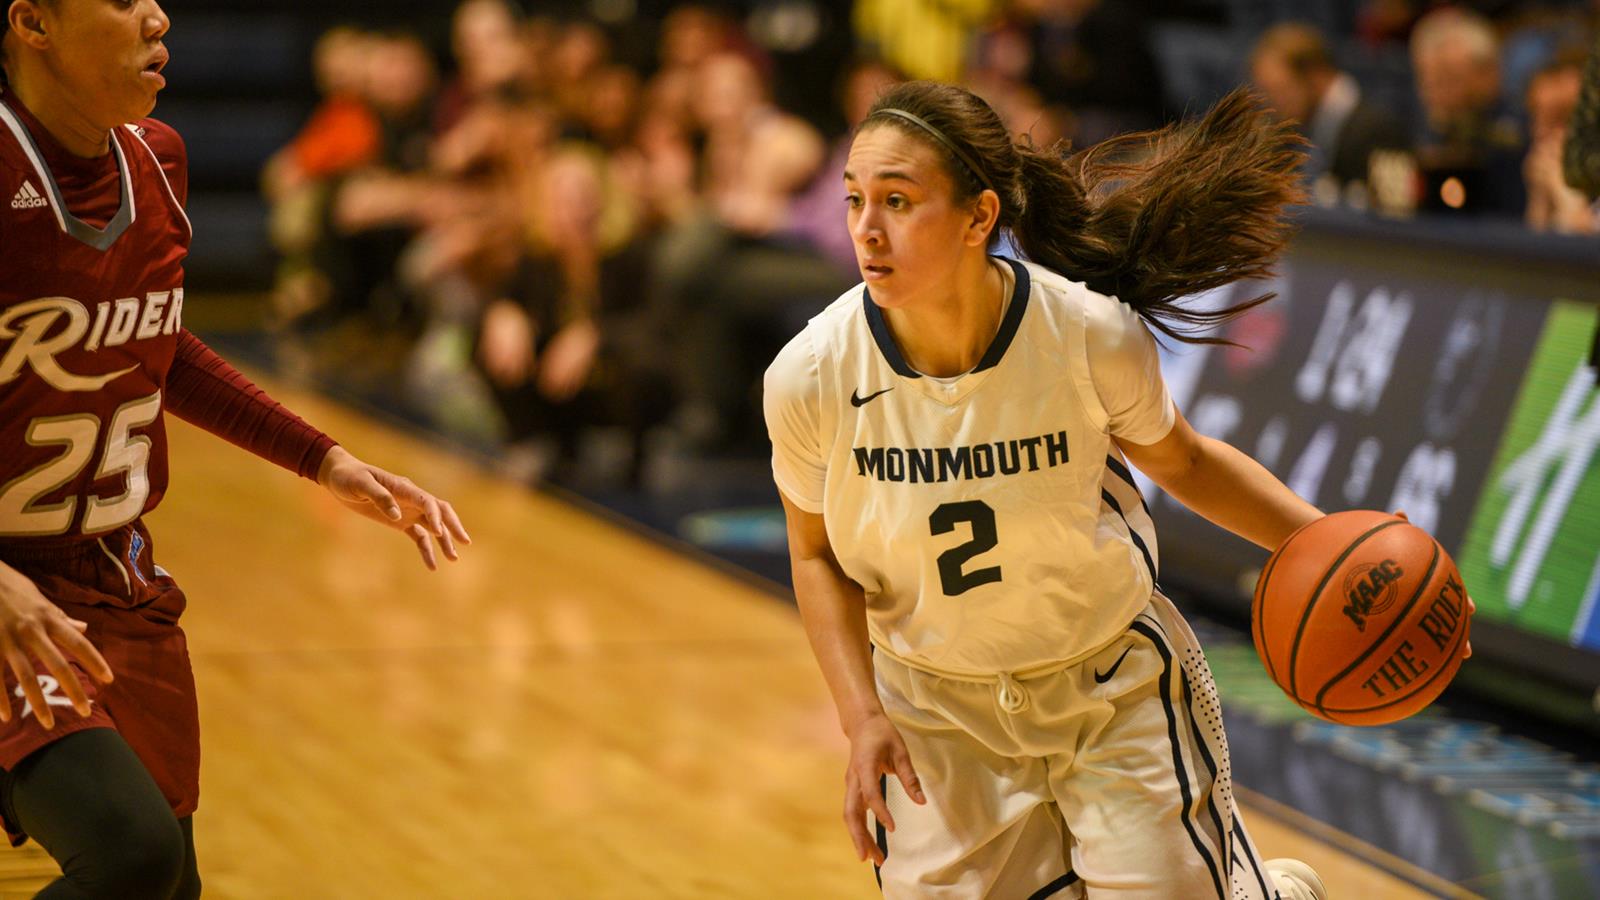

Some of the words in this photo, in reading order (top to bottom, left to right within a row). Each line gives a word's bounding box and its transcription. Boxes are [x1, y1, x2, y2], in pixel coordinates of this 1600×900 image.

[11, 196, 48, 209] adidas
[0, 287, 184, 392] RIDER
[0, 388, 162, 536] 25
[853, 430, 1069, 483] MONMOUTH
[929, 500, 1002, 596] 2
[1342, 558, 1404, 632] MAAC
[1362, 640, 1429, 698] THE
[1417, 573, 1464, 653] ROCK
